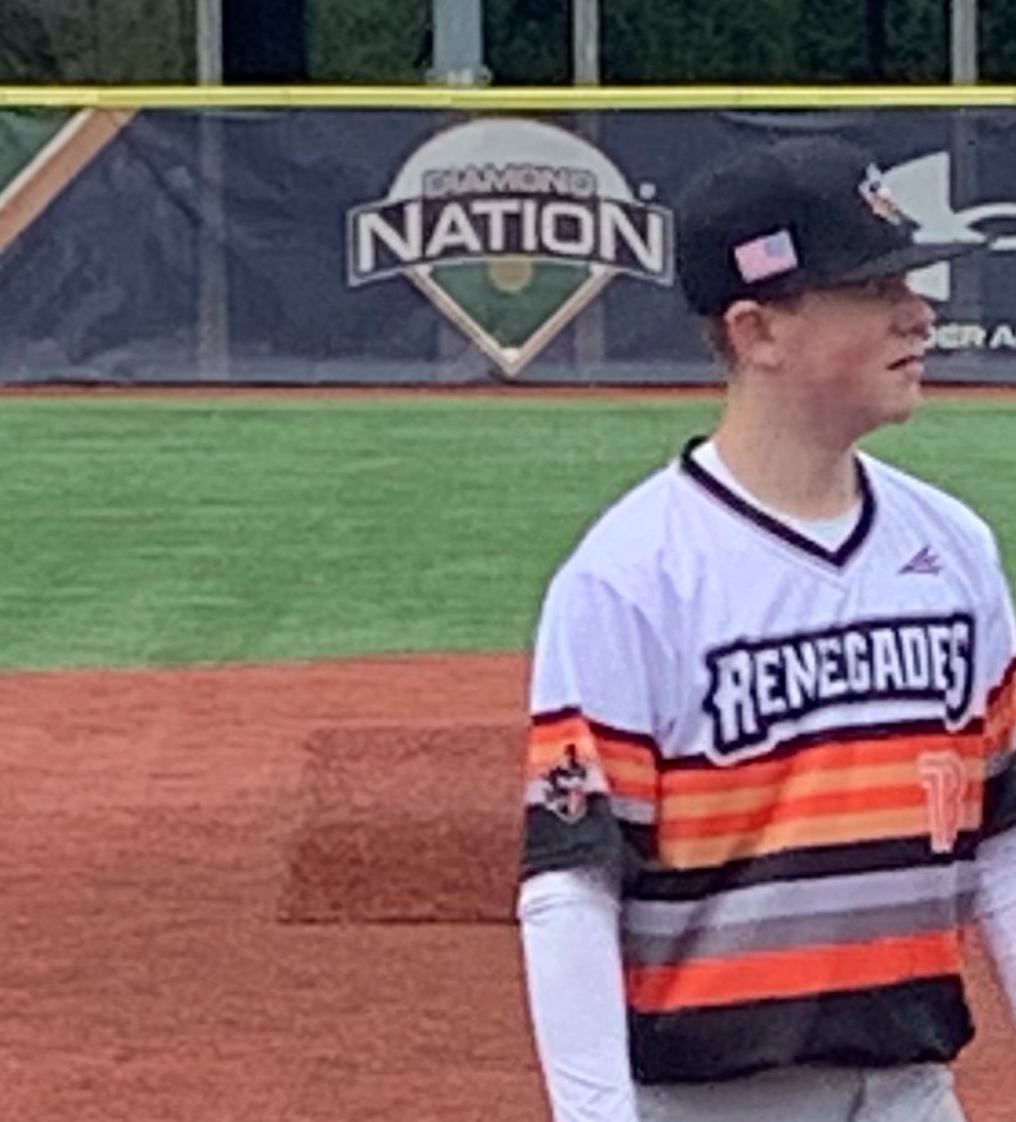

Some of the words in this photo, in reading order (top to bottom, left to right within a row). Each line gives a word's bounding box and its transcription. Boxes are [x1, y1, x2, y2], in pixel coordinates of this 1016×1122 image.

[422, 164, 597, 198] DIAMOND
[358, 200, 664, 272] NATION
[713, 623, 968, 743] RENEGADES
